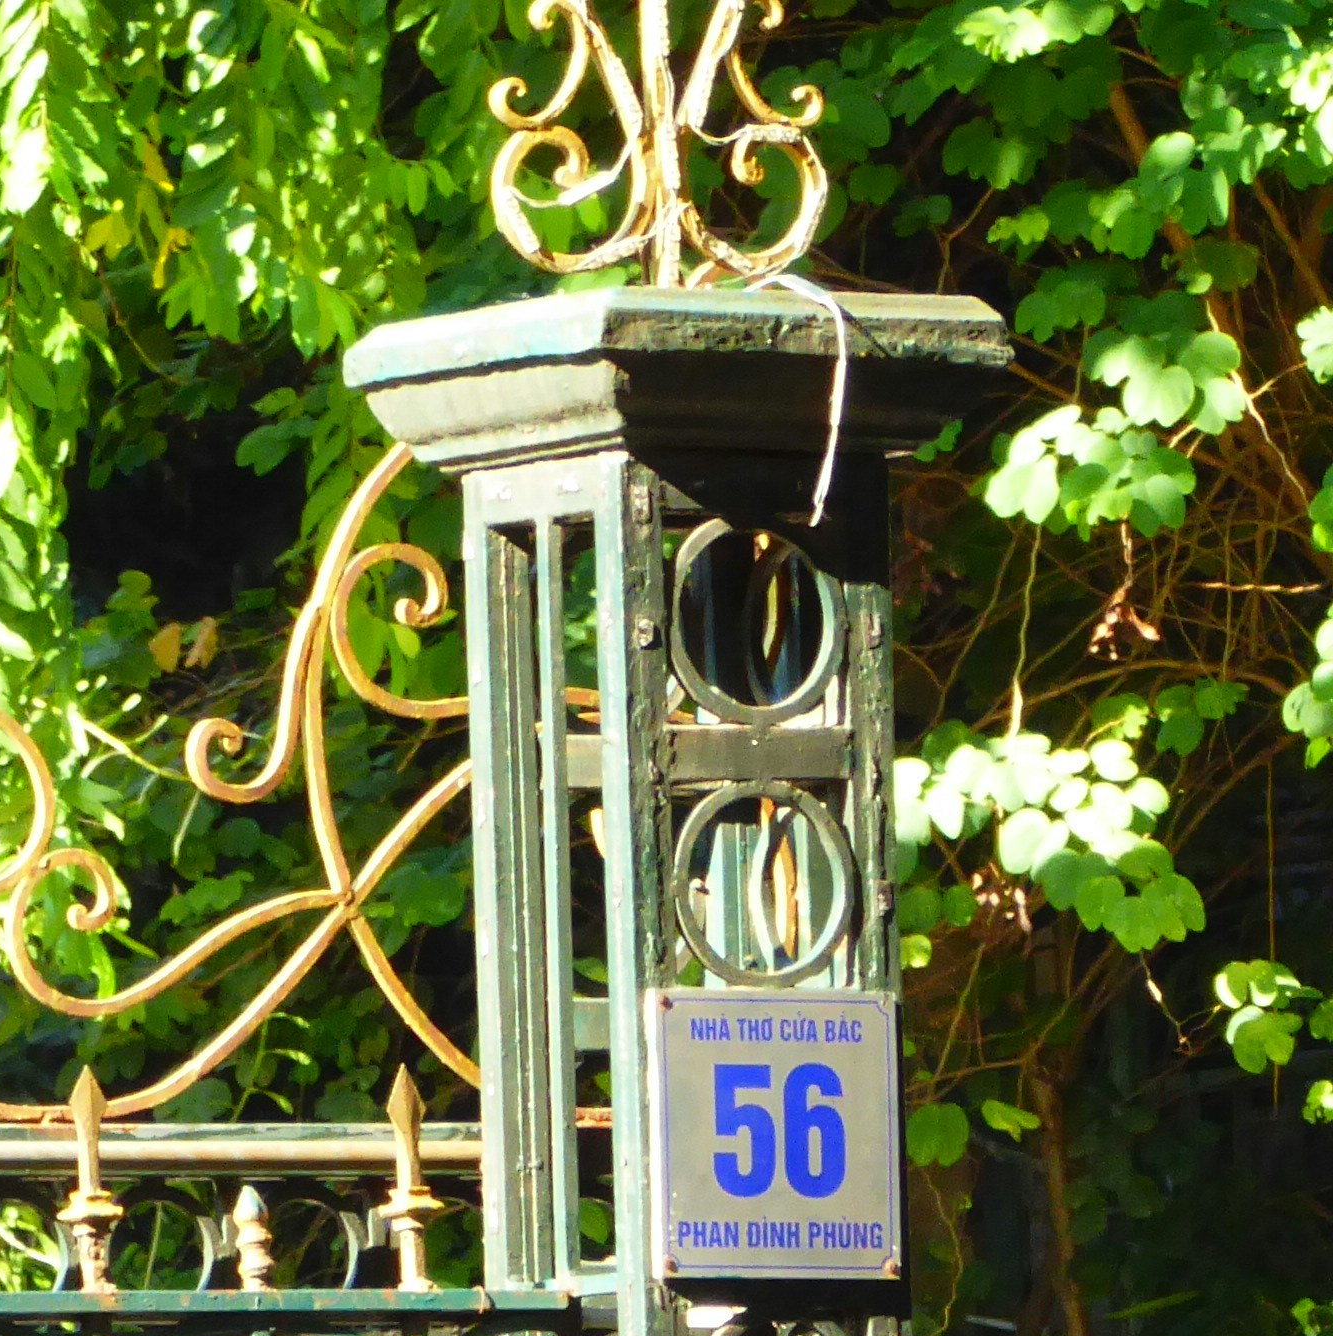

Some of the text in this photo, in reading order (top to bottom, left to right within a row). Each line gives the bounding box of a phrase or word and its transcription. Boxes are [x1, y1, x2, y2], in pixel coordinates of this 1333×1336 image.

[713, 1062, 845, 1200] 56
[677, 1216, 883, 1249] PHAN ĐÌNH PHÙNG
